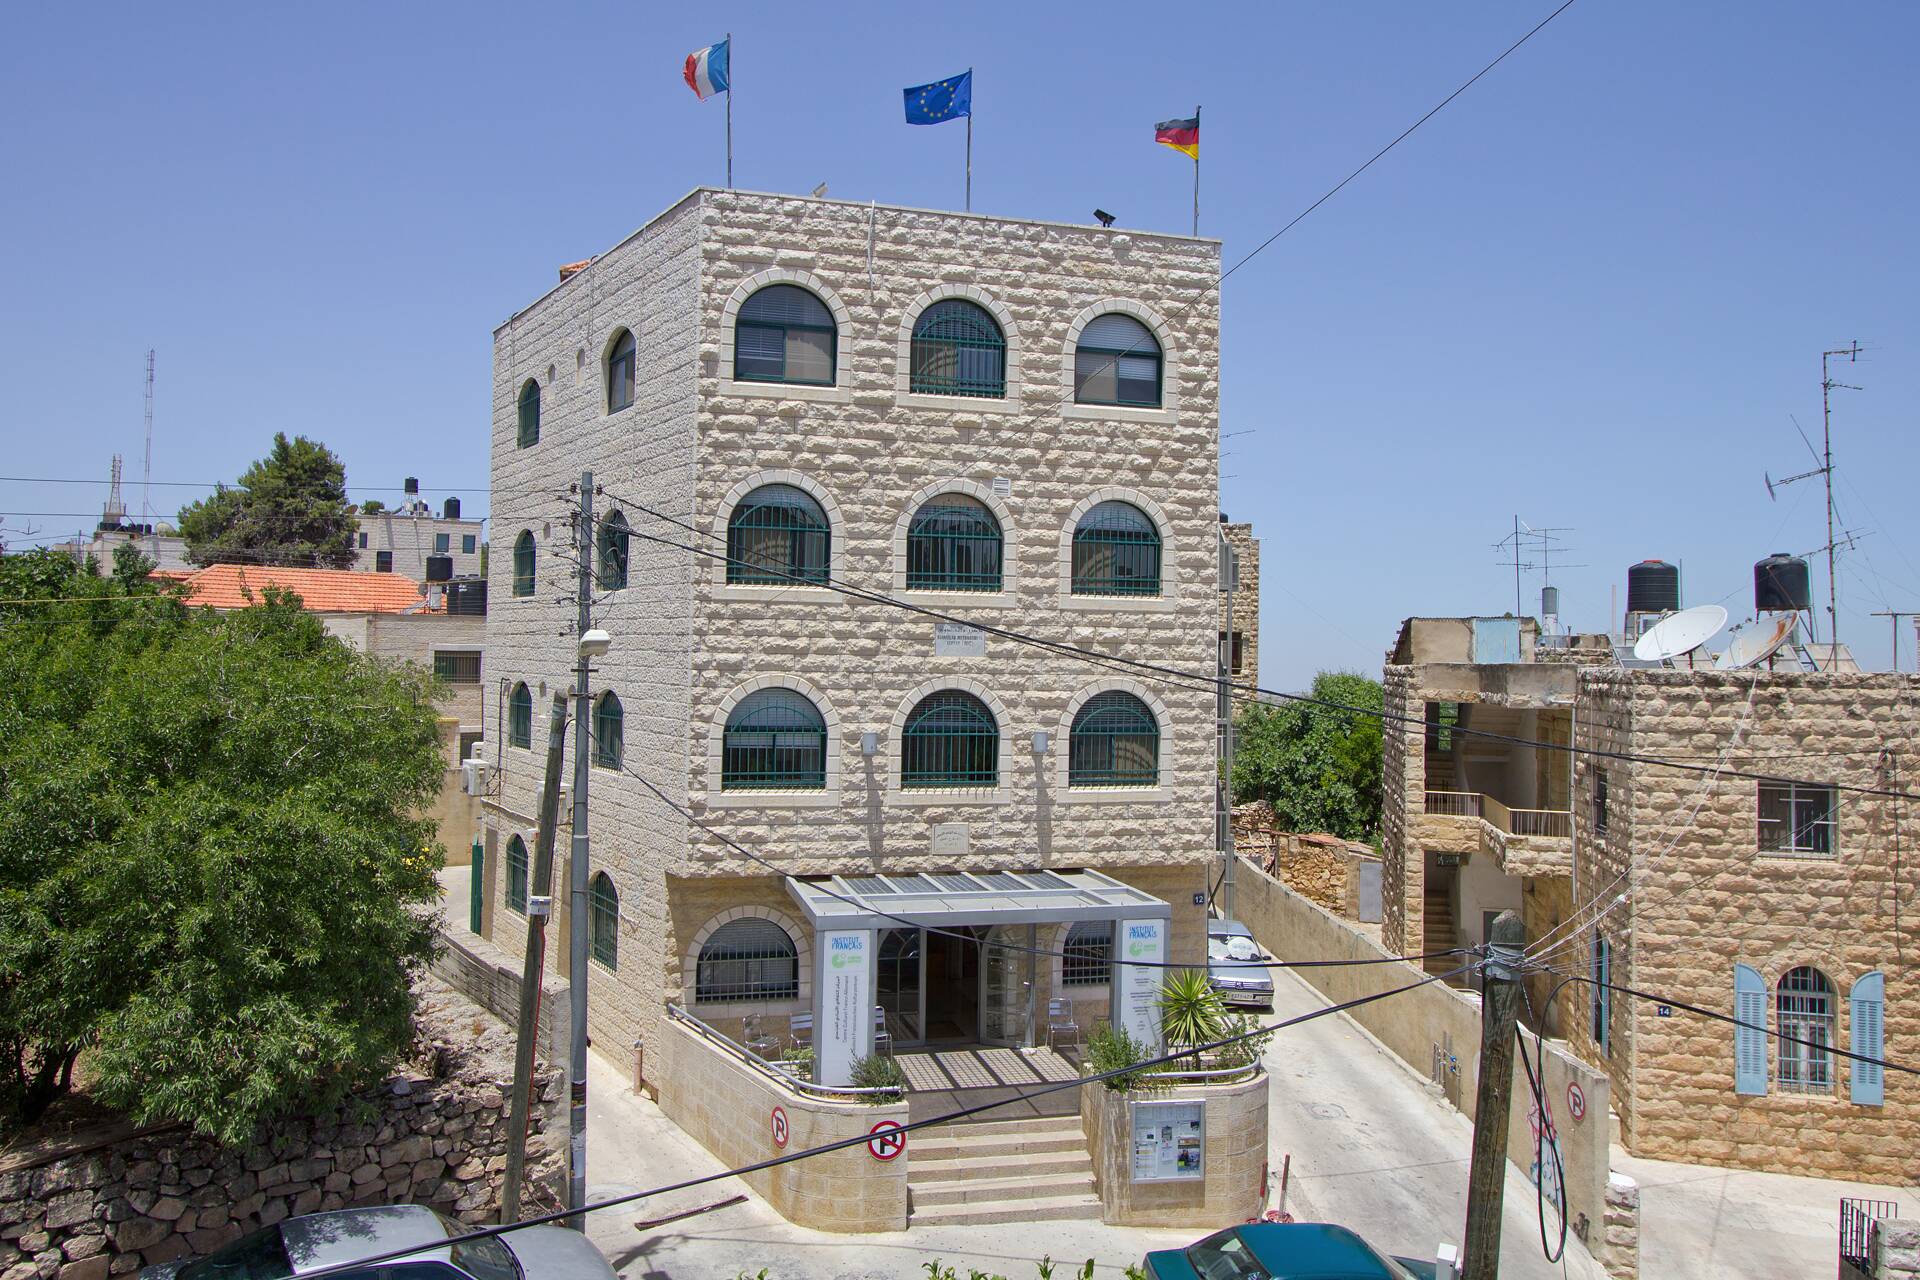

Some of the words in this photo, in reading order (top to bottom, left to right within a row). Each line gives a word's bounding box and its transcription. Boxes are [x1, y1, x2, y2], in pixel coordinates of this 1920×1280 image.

[1194, 894, 1204, 904] 12
[831, 936, 859, 944] INSTITUT
[1660, 1007, 1670, 1016] 14
